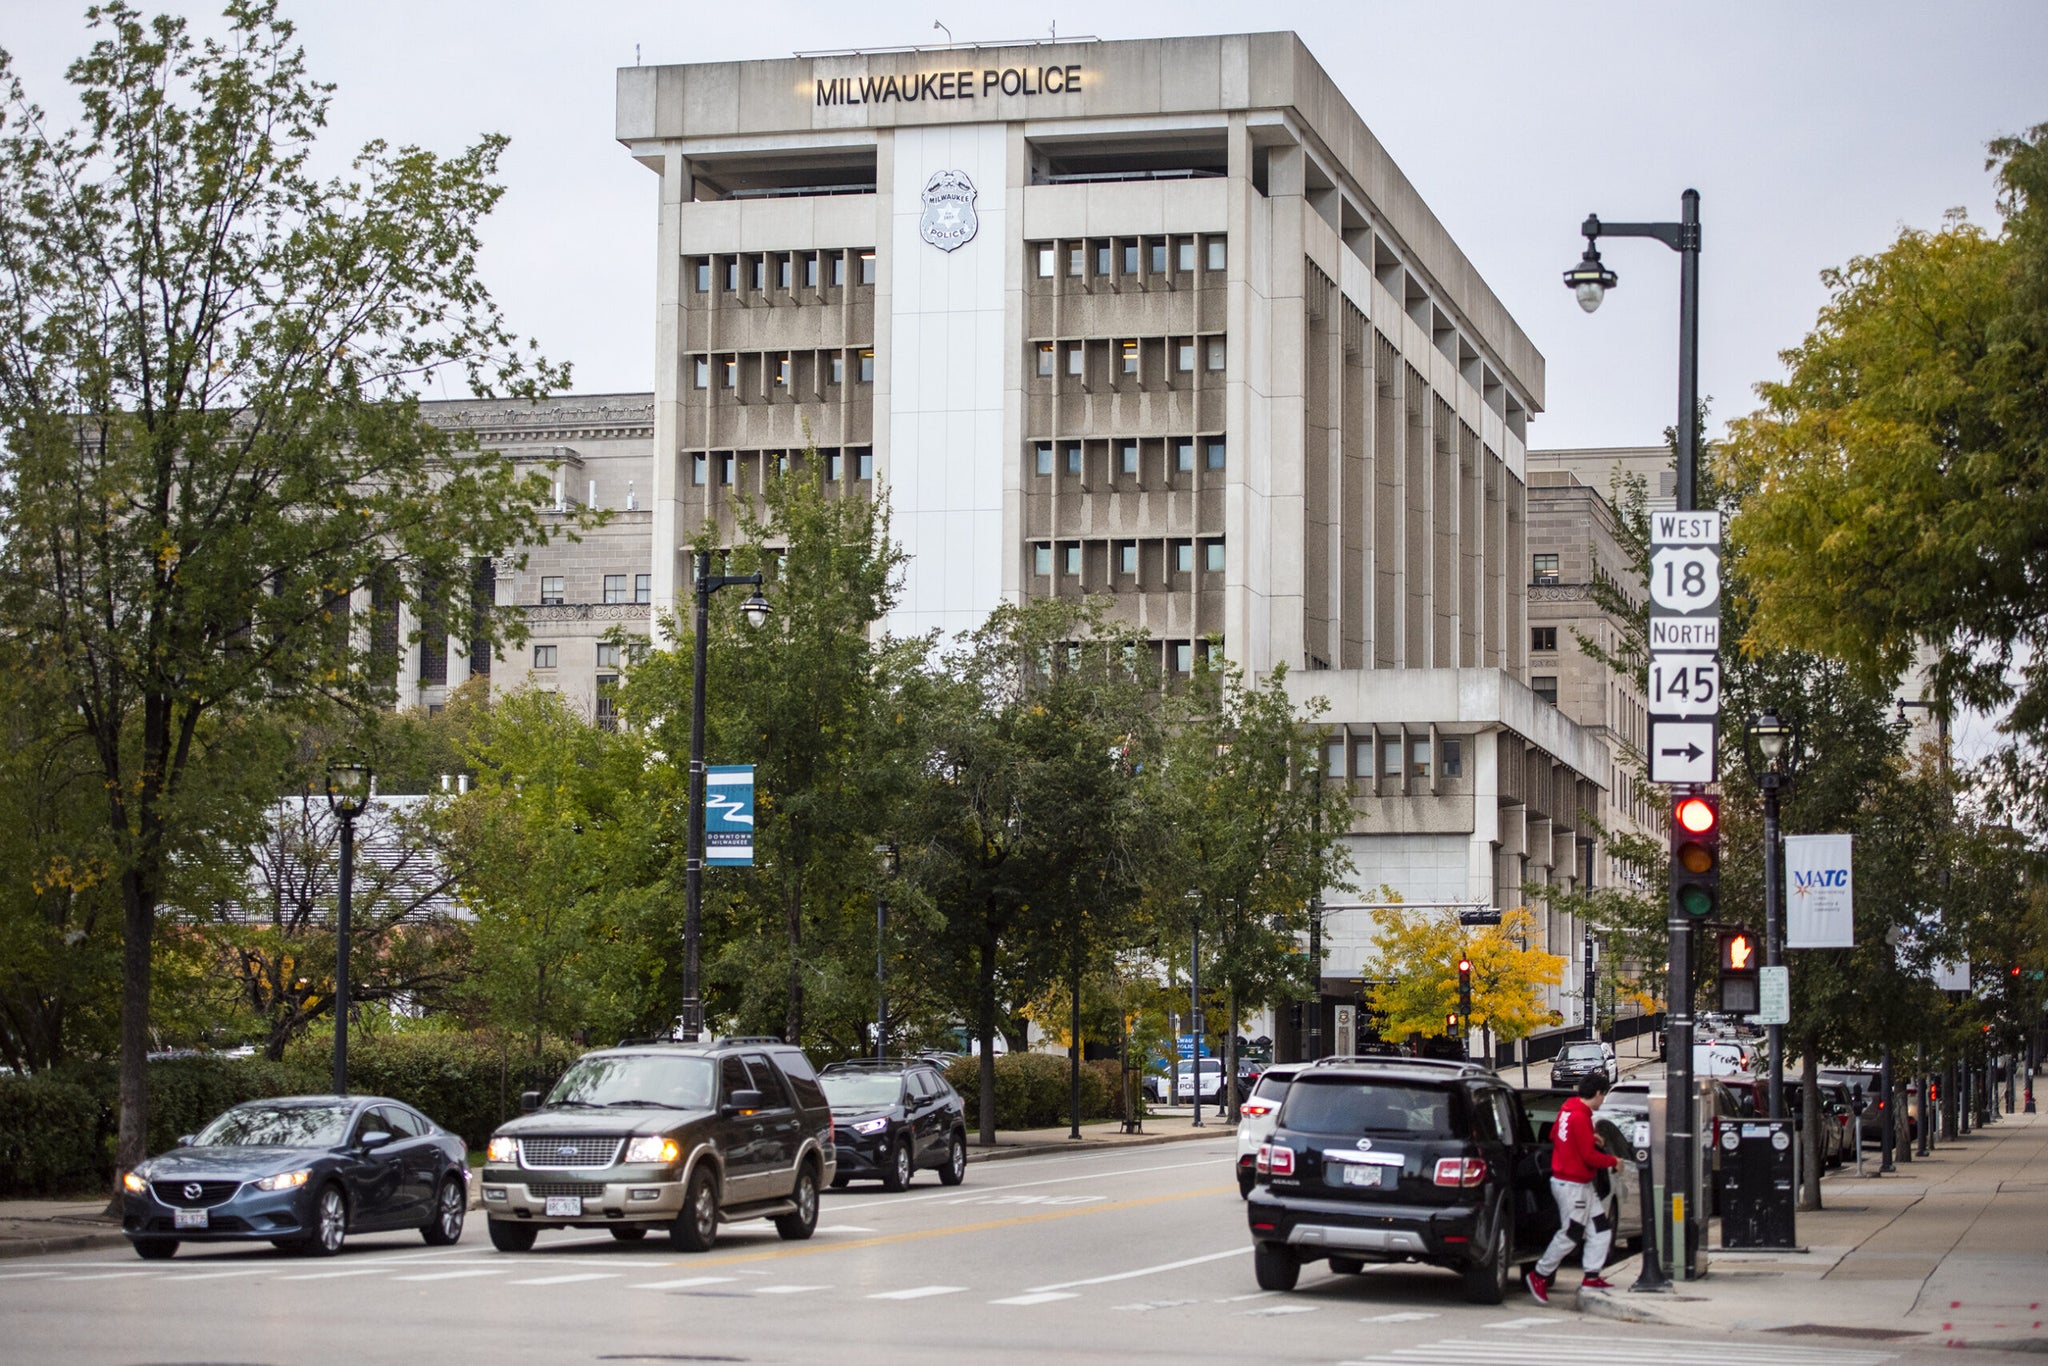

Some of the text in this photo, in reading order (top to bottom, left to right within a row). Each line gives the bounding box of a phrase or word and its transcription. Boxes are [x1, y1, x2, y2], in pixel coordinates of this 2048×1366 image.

[817, 65, 1081, 106] MILWAUKEE POLICE
[929, 194, 969, 203] MILWAUKEE
[930, 228, 966, 238] POLICE
[1660, 517, 1712, 538] WEST
[1664, 561, 1706, 597] 18
[1653, 622, 1716, 644] NORTH
[1654, 667, 1714, 703] 145
[1792, 869, 1848, 888] MATC
